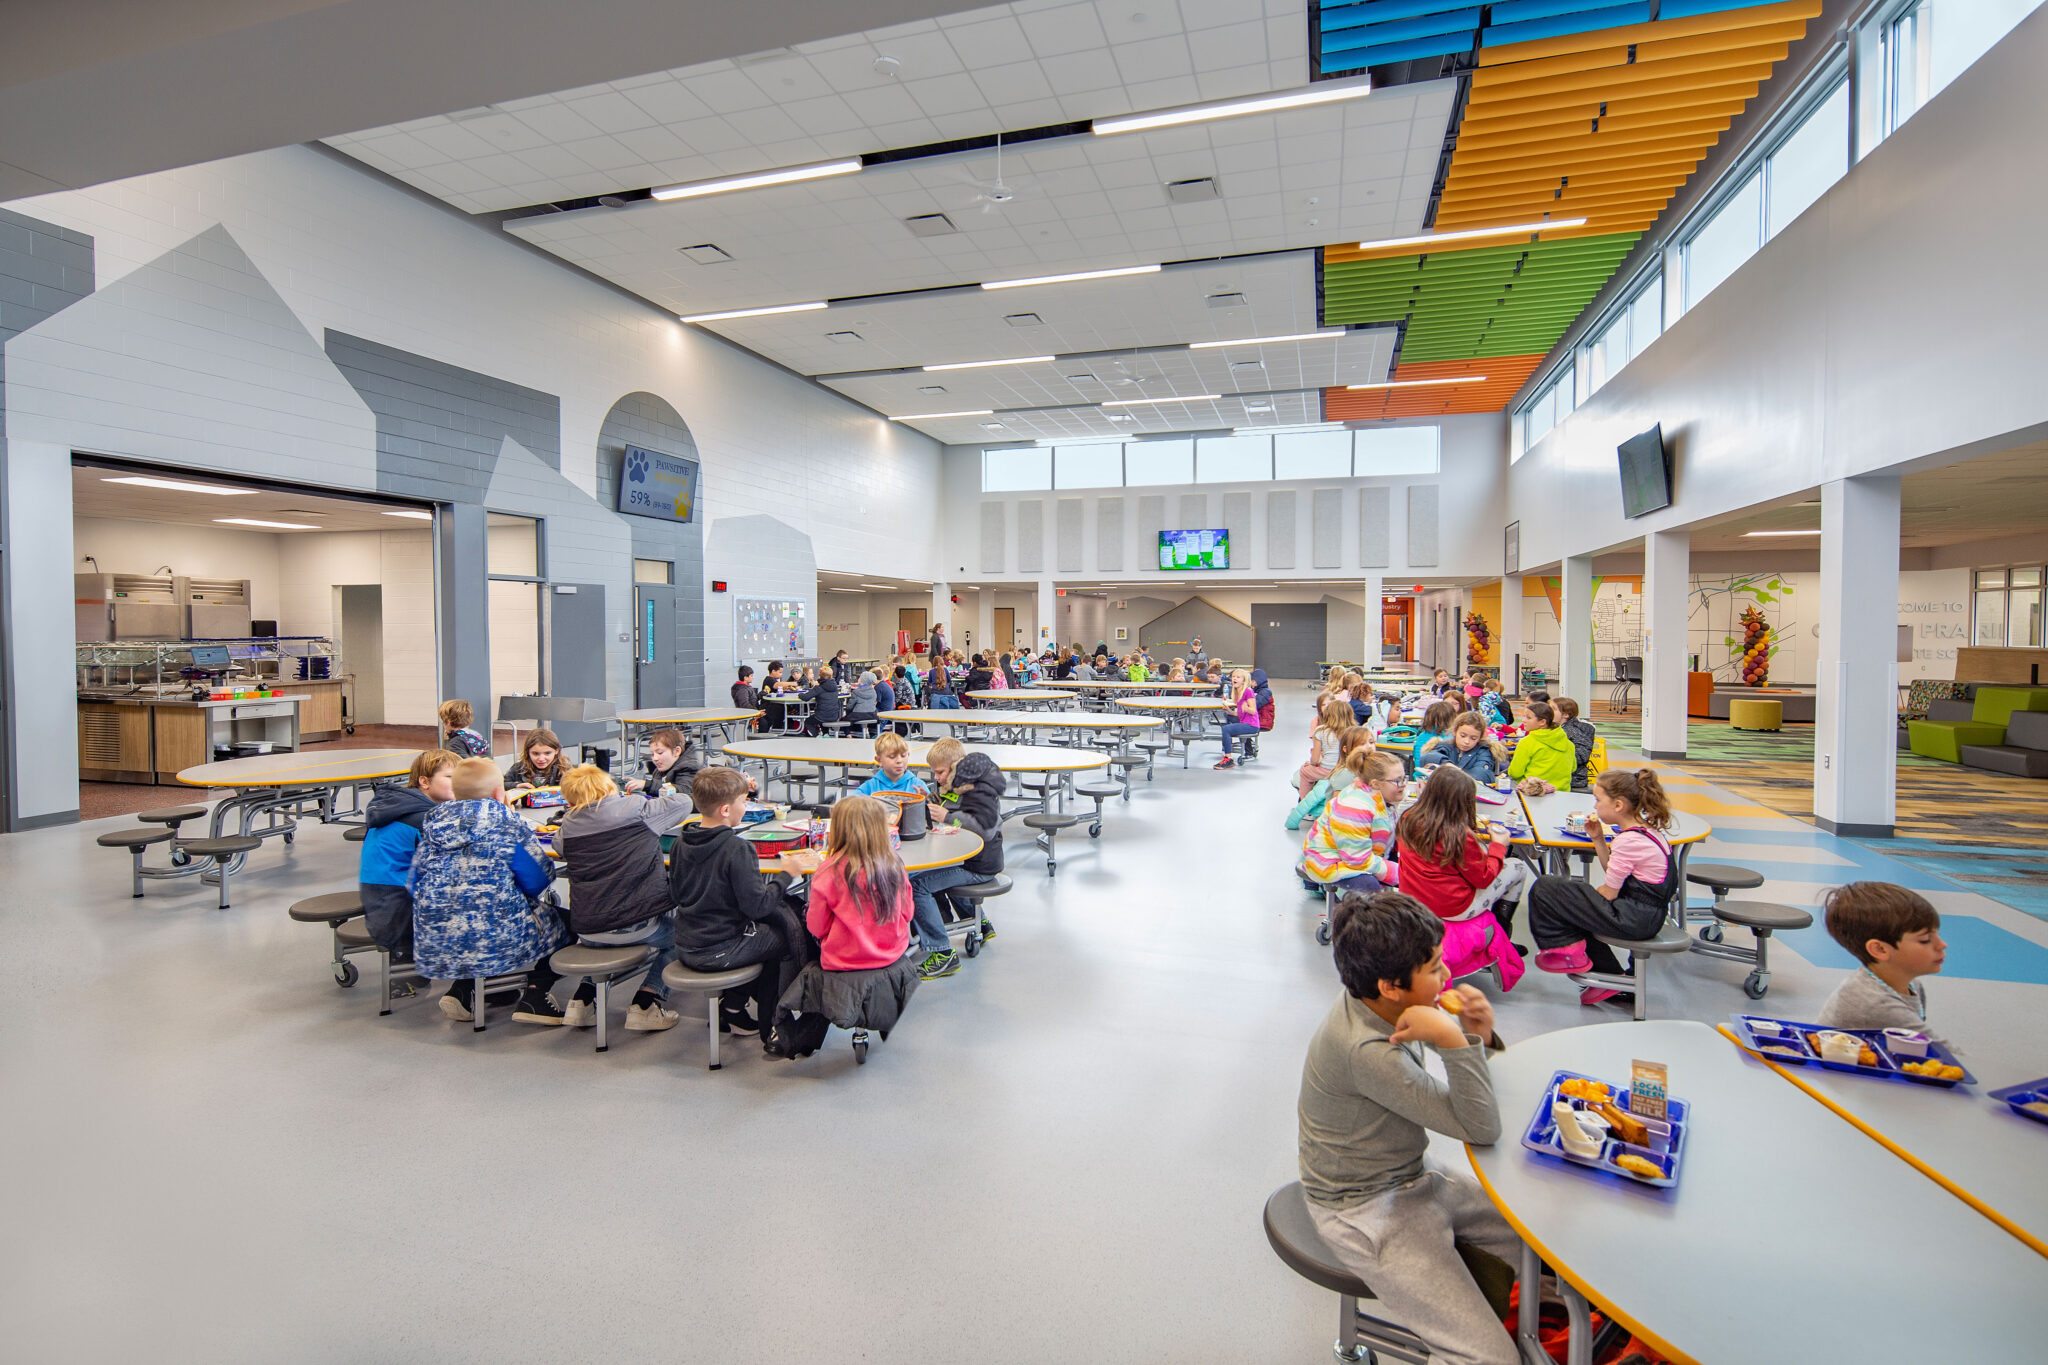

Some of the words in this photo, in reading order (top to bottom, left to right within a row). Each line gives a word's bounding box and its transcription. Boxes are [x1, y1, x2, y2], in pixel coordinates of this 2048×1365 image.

[655, 459, 690, 476] PAWSITIVE
[630, 490, 651, 506] 59%
[1943, 602, 1964, 613] TO
[1633, 1081, 1664, 1093] LOCAL
[1633, 1104, 1664, 1118] MILK
